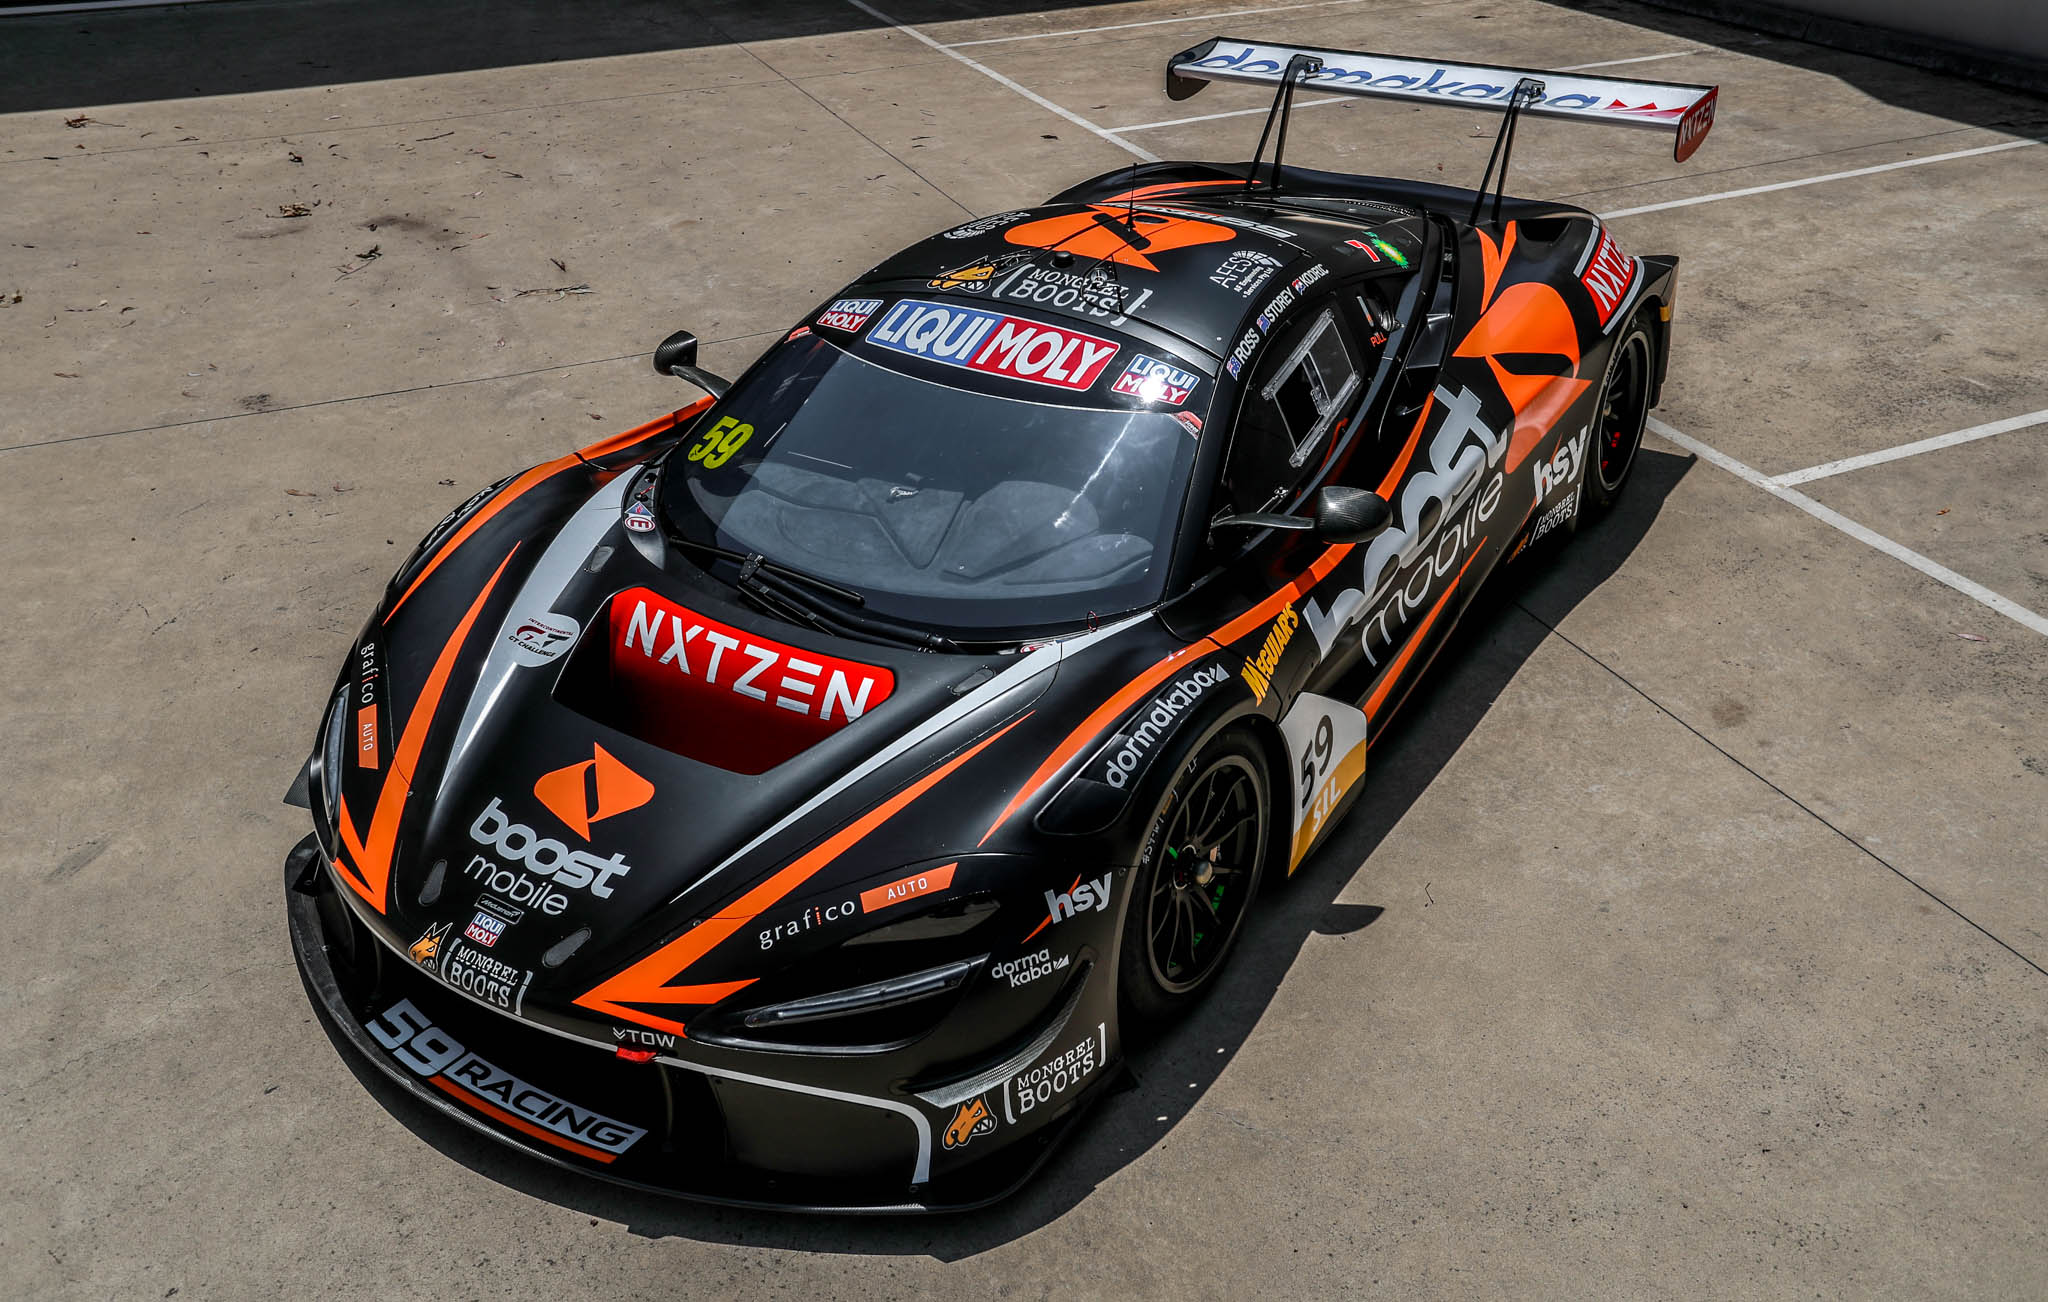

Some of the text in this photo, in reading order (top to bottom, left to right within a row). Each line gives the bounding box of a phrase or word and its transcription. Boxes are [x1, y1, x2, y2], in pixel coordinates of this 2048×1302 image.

[1191, 48, 1600, 109] domakaa
[821, 312, 865, 330] MOLY
[831, 300, 876, 315] LIQUI
[1008, 279, 1119, 317] BOOTS
[1234, 263, 1329, 365] ROSS STOREY KODRIC
[873, 304, 1117, 384] LIQUI MOLY
[1130, 357, 1196, 389] LIQUI
[687, 415, 755, 470] 59
[1533, 425, 1588, 508] hsy
[1303, 384, 1508, 662] boost
[1535, 502, 1574, 540] BOOTS
[1361, 471, 1503, 667] mobile
[360, 642, 379, 704] grafico
[518, 641, 556, 658] CHALLENGE
[624, 599, 875, 724] NXTZEN
[362, 723, 374, 752] AUTO
[1106, 670, 1216, 789] dormakaba
[1300, 714, 1334, 809] 59
[1312, 775, 1342, 833] SIL
[469, 796, 632, 899] boost
[463, 854, 569, 916] mobile
[1043, 871, 1113, 925] hsy
[466, 924, 498, 945] MOLY
[473, 913, 505, 935] LIQUI
[758, 877, 929, 951] grafico AUTO
[450, 962, 511, 1009] BOOTS
[456, 944, 519, 987] MONGREL
[991, 948, 1051, 980] dorma
[1009, 962, 1053, 989] kaba
[626, 1028, 676, 1049] TOW
[1016, 1036, 1096, 1092] MONGREL
[364, 997, 638, 1150] 59 RACING
[1016, 1051, 1095, 1115] BOOTS
